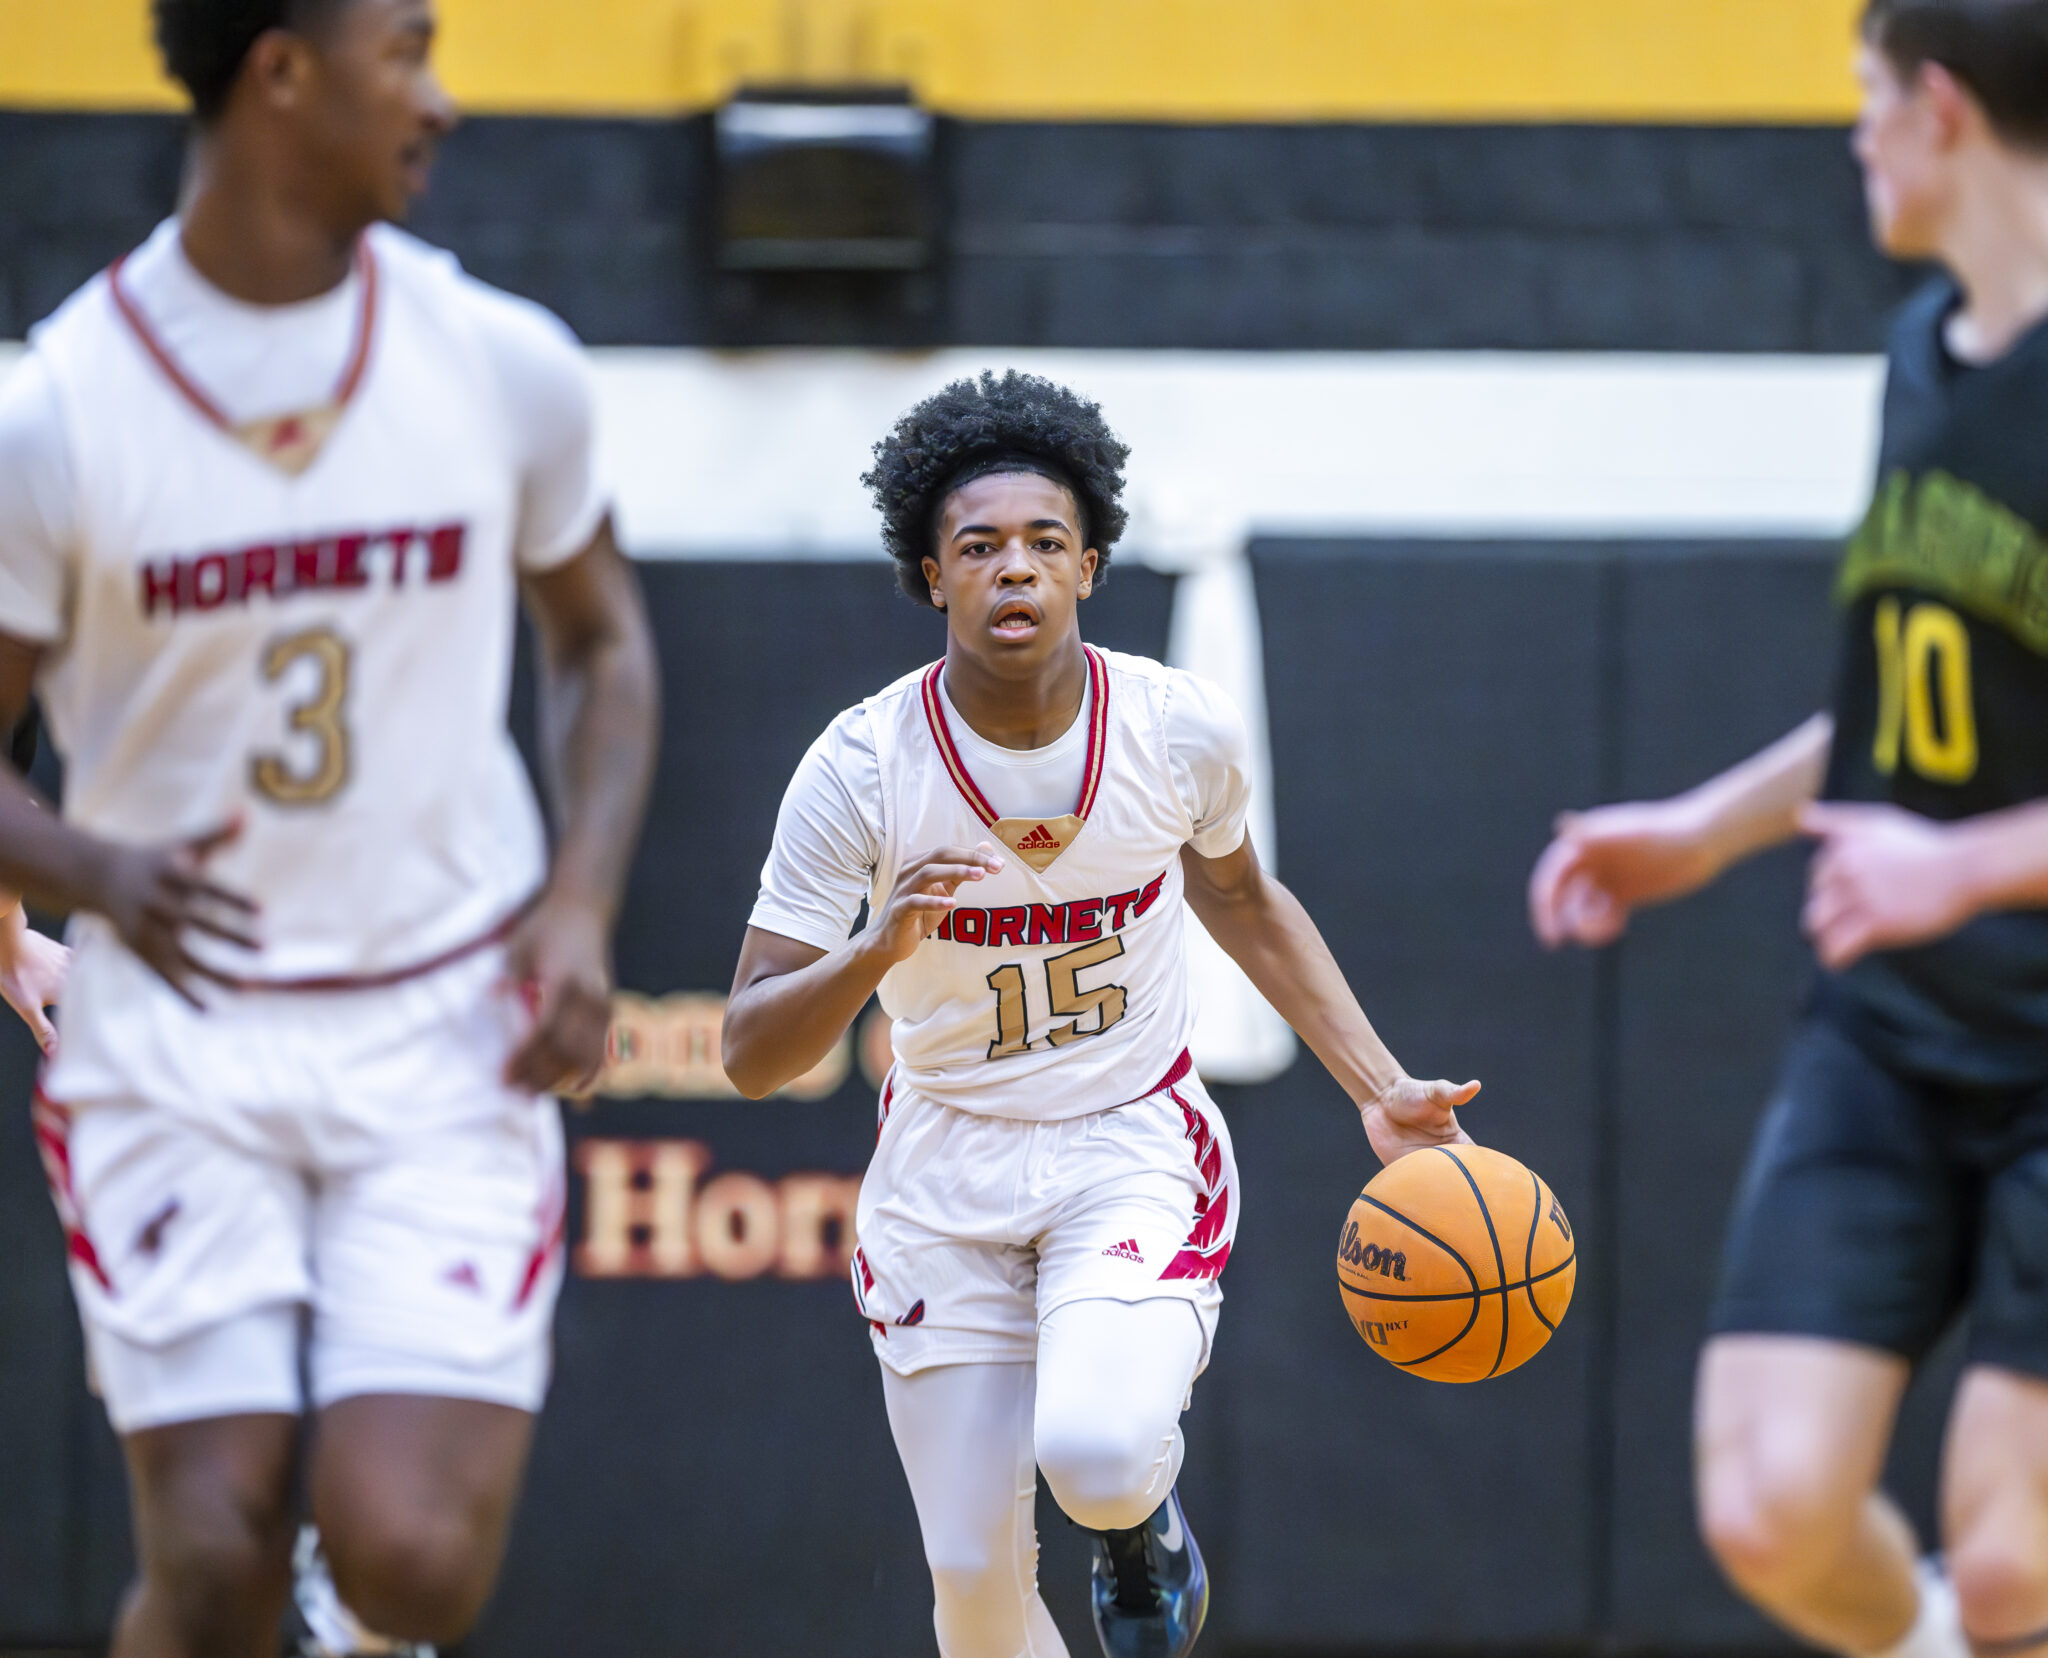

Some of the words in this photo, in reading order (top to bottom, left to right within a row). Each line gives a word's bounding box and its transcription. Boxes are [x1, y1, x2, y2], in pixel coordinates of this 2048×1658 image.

[248, 622, 353, 811] 3
[1873, 594, 1979, 786] 10
[1017, 839, 1060, 850] adidas
[986, 934, 1128, 1061] 15
[1101, 1248, 1145, 1265] adidas
